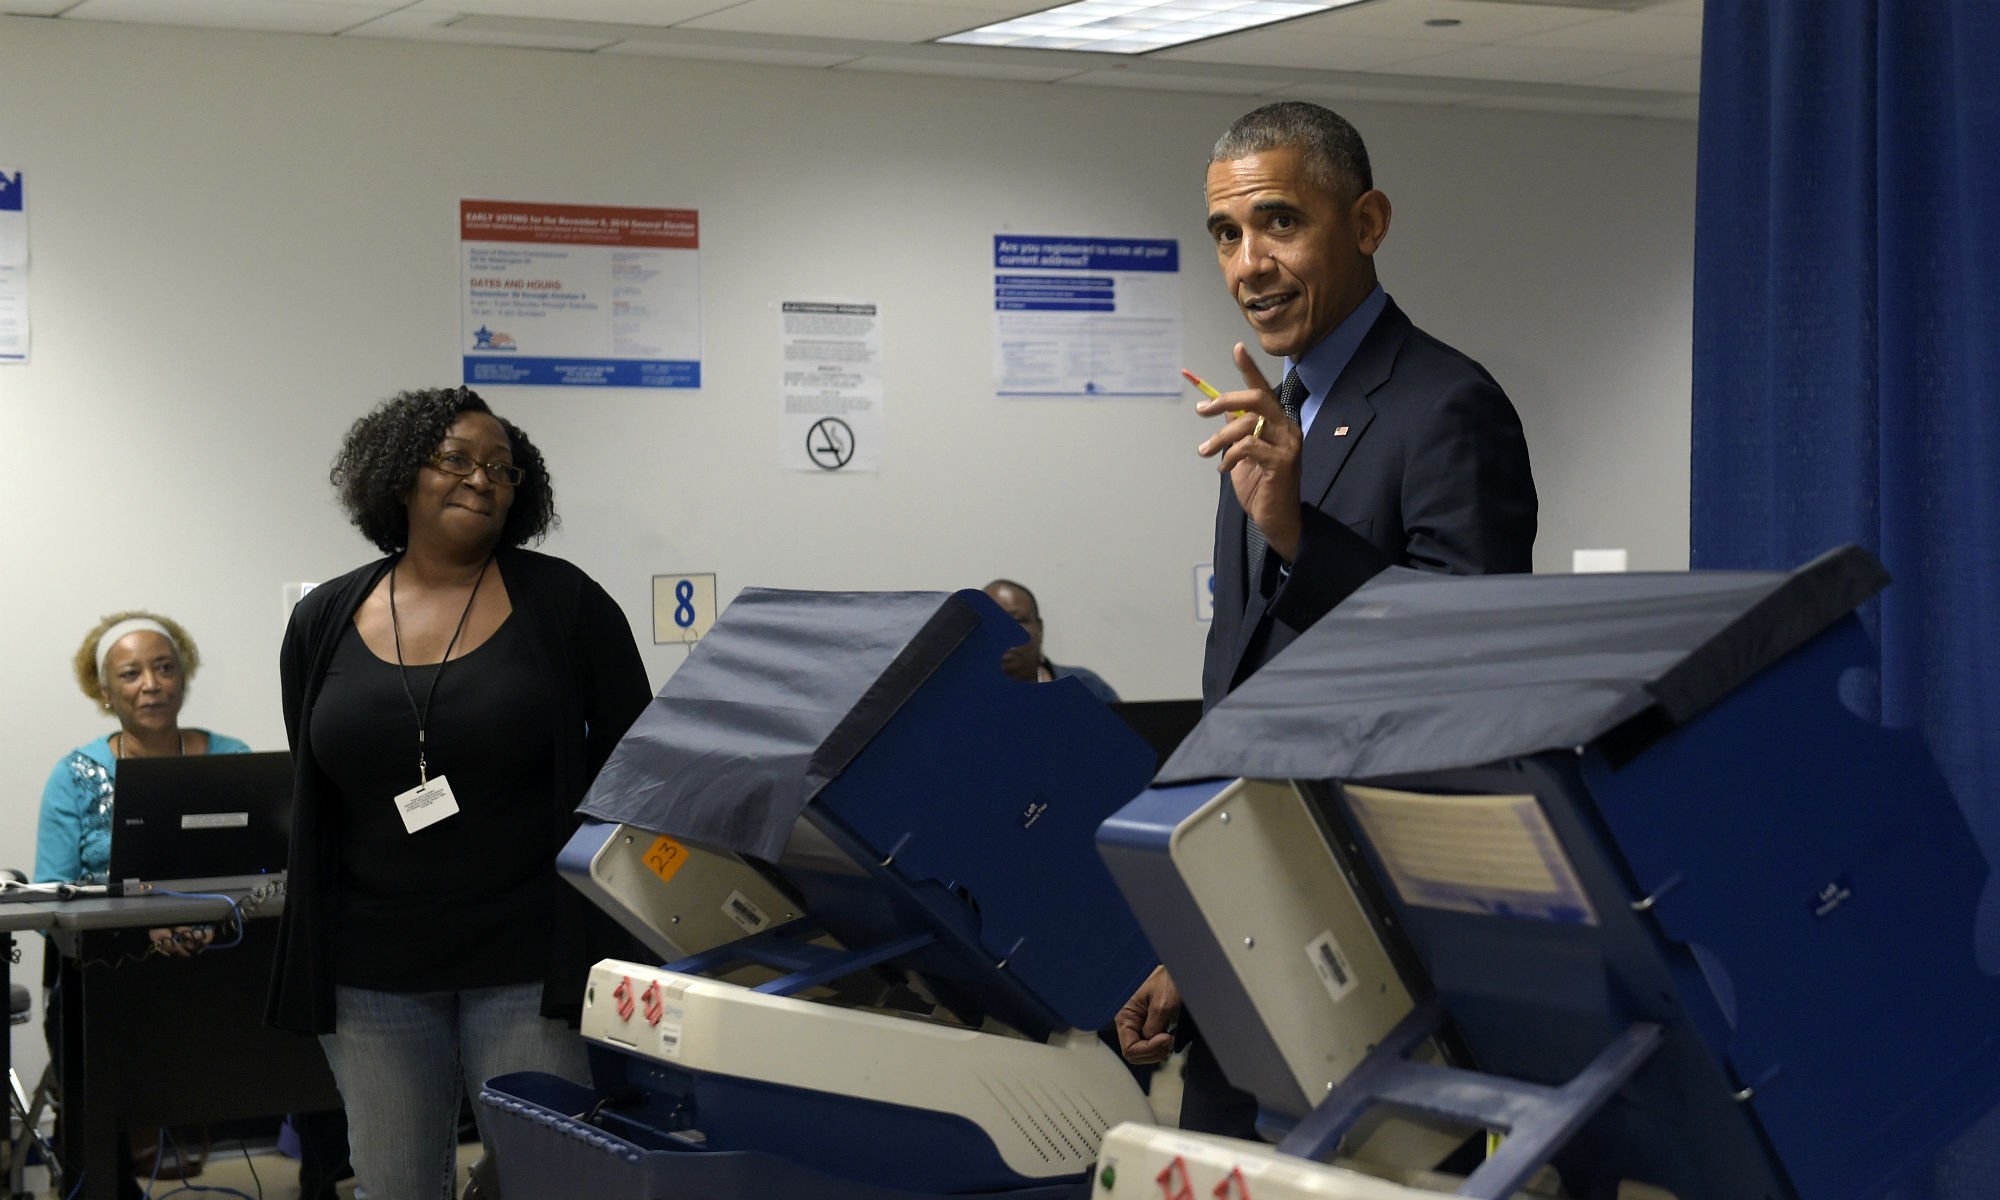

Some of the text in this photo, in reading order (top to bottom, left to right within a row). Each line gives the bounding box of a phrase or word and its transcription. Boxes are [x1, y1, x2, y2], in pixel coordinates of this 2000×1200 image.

[465, 212, 493, 222] EARLY
[495, 213, 529, 223] VOTING
[530, 215, 541, 224] for
[543, 215, 557, 224] the
[998, 241, 1169, 258] Are you registered to vote at your
[999, 255, 1089, 267] current address?
[470, 278, 502, 288] DATES
[504, 279, 524, 288] AND
[674, 579, 696, 628] 8
[650, 841, 678, 875] 23
